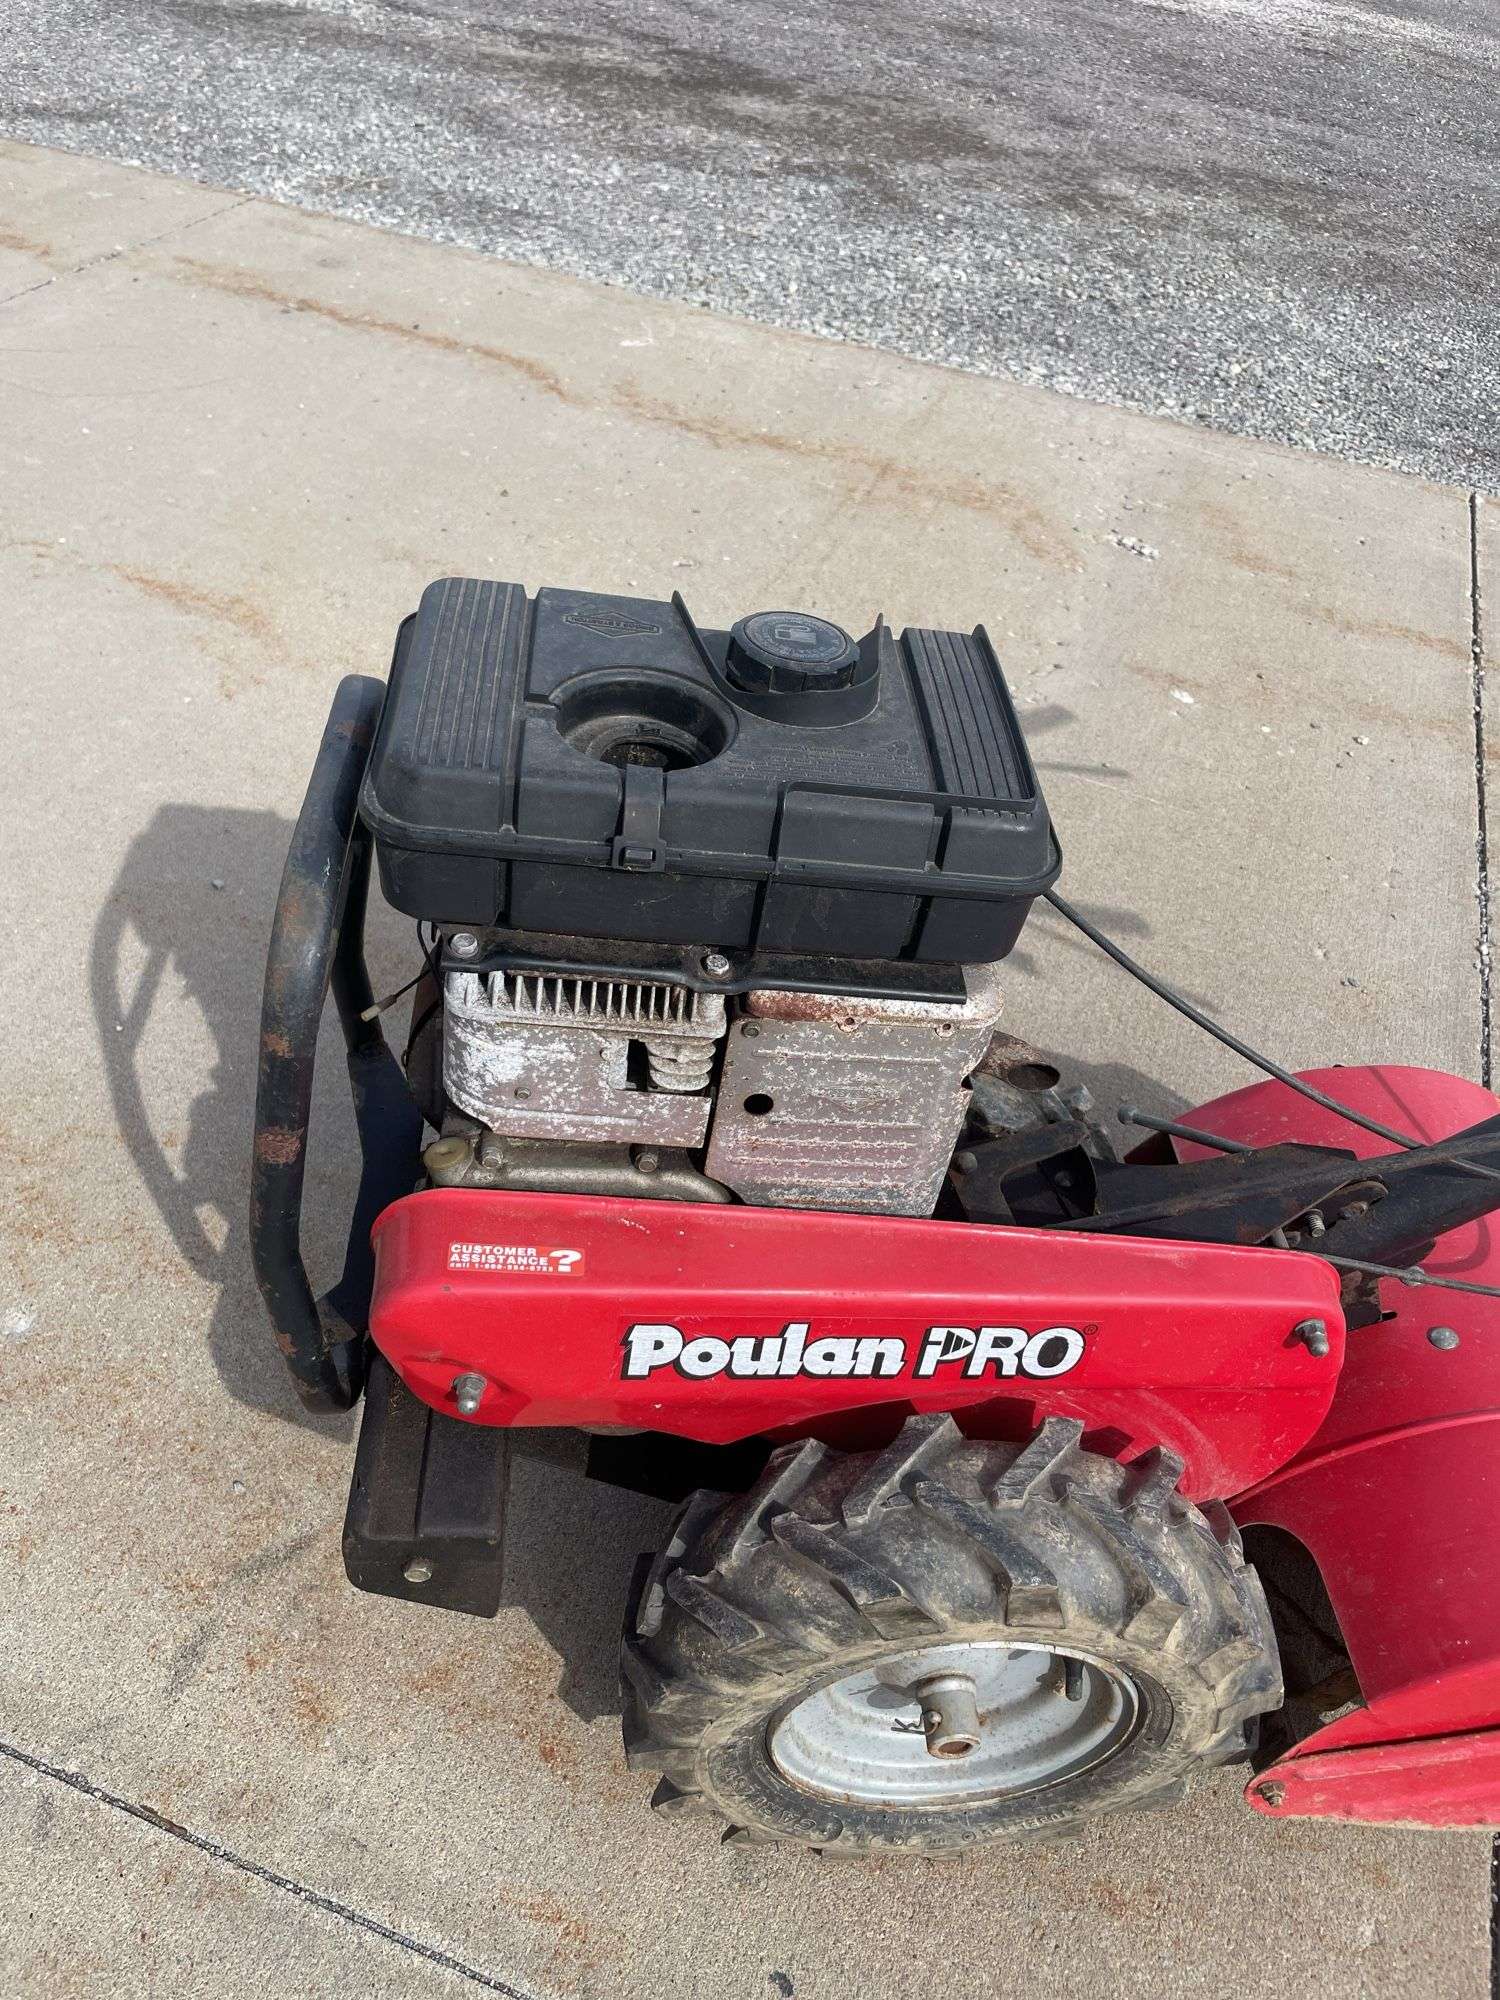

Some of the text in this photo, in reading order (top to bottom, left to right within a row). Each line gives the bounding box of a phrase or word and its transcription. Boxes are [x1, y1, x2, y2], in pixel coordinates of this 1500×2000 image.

[450, 1243, 537, 1257] CUSTOMER
[450, 1253, 549, 1266] ASSISTANCE
[620, 1322, 1087, 1380] Poulan PRO
